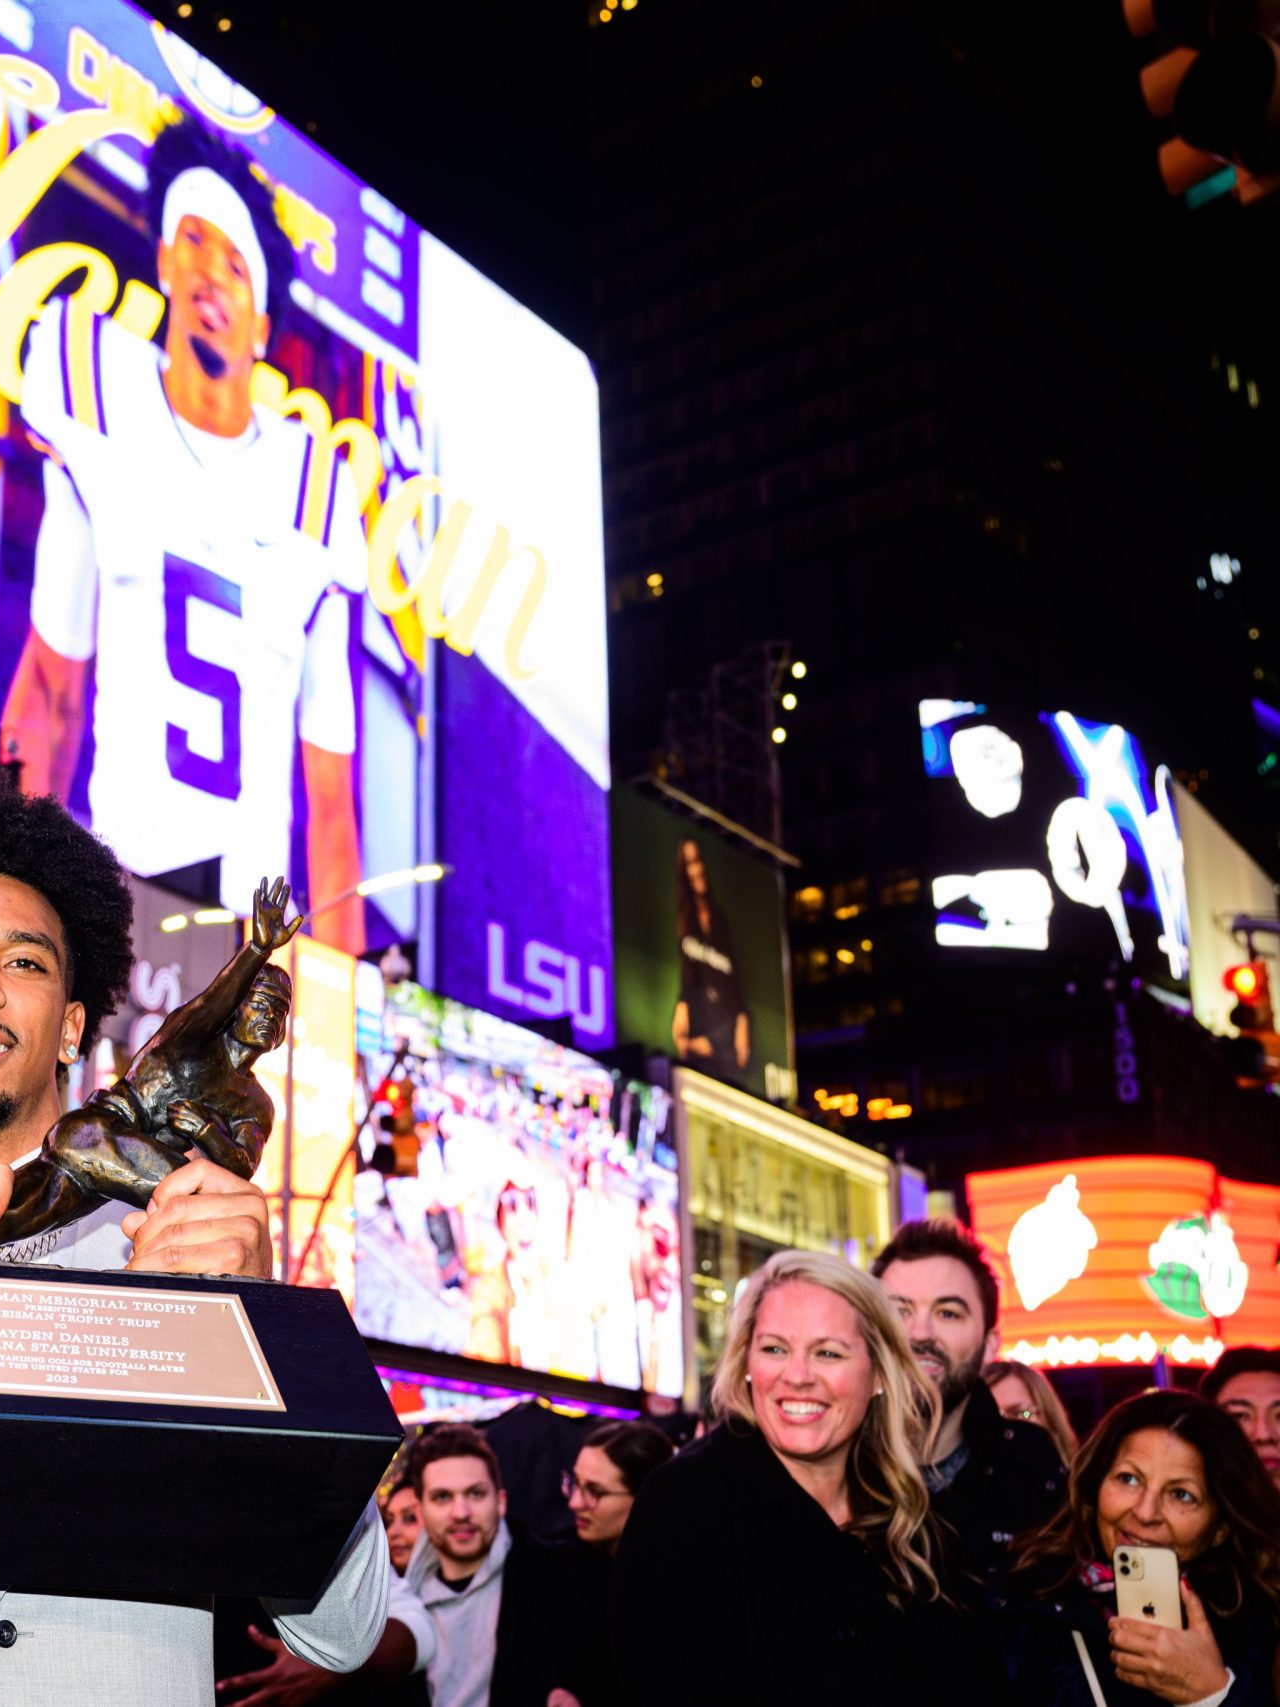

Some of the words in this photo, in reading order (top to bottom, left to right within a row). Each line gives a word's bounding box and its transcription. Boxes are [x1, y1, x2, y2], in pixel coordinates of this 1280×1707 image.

[163, 550, 242, 801] 5
[487, 922, 606, 1035] LSU
[25, 1304, 79, 1314] PRESENTED
[39, 1295, 128, 1310] MEMORIAL
[132, 1301, 197, 1314] TROPHY
[53, 1322, 67, 1330] TO
[59, 1314, 113, 1325] TROPHY
[117, 1317, 160, 1328] TRUST
[60, 1332, 129, 1346] DANIELS
[31, 1342, 80, 1355] STATE
[85, 1346, 186, 1362] UNIVERSITY
[31, 1363, 70, 1372] UNITED
[72, 1366, 107, 1375] STATES
[109, 1368, 129, 1376] FOR
[48, 1358, 92, 1367] COLLEGE
[96, 1361, 146, 1370] FOOTBALL
[148, 1364, 186, 1373] PLAYER
[46, 1374, 78, 1384] 2023
